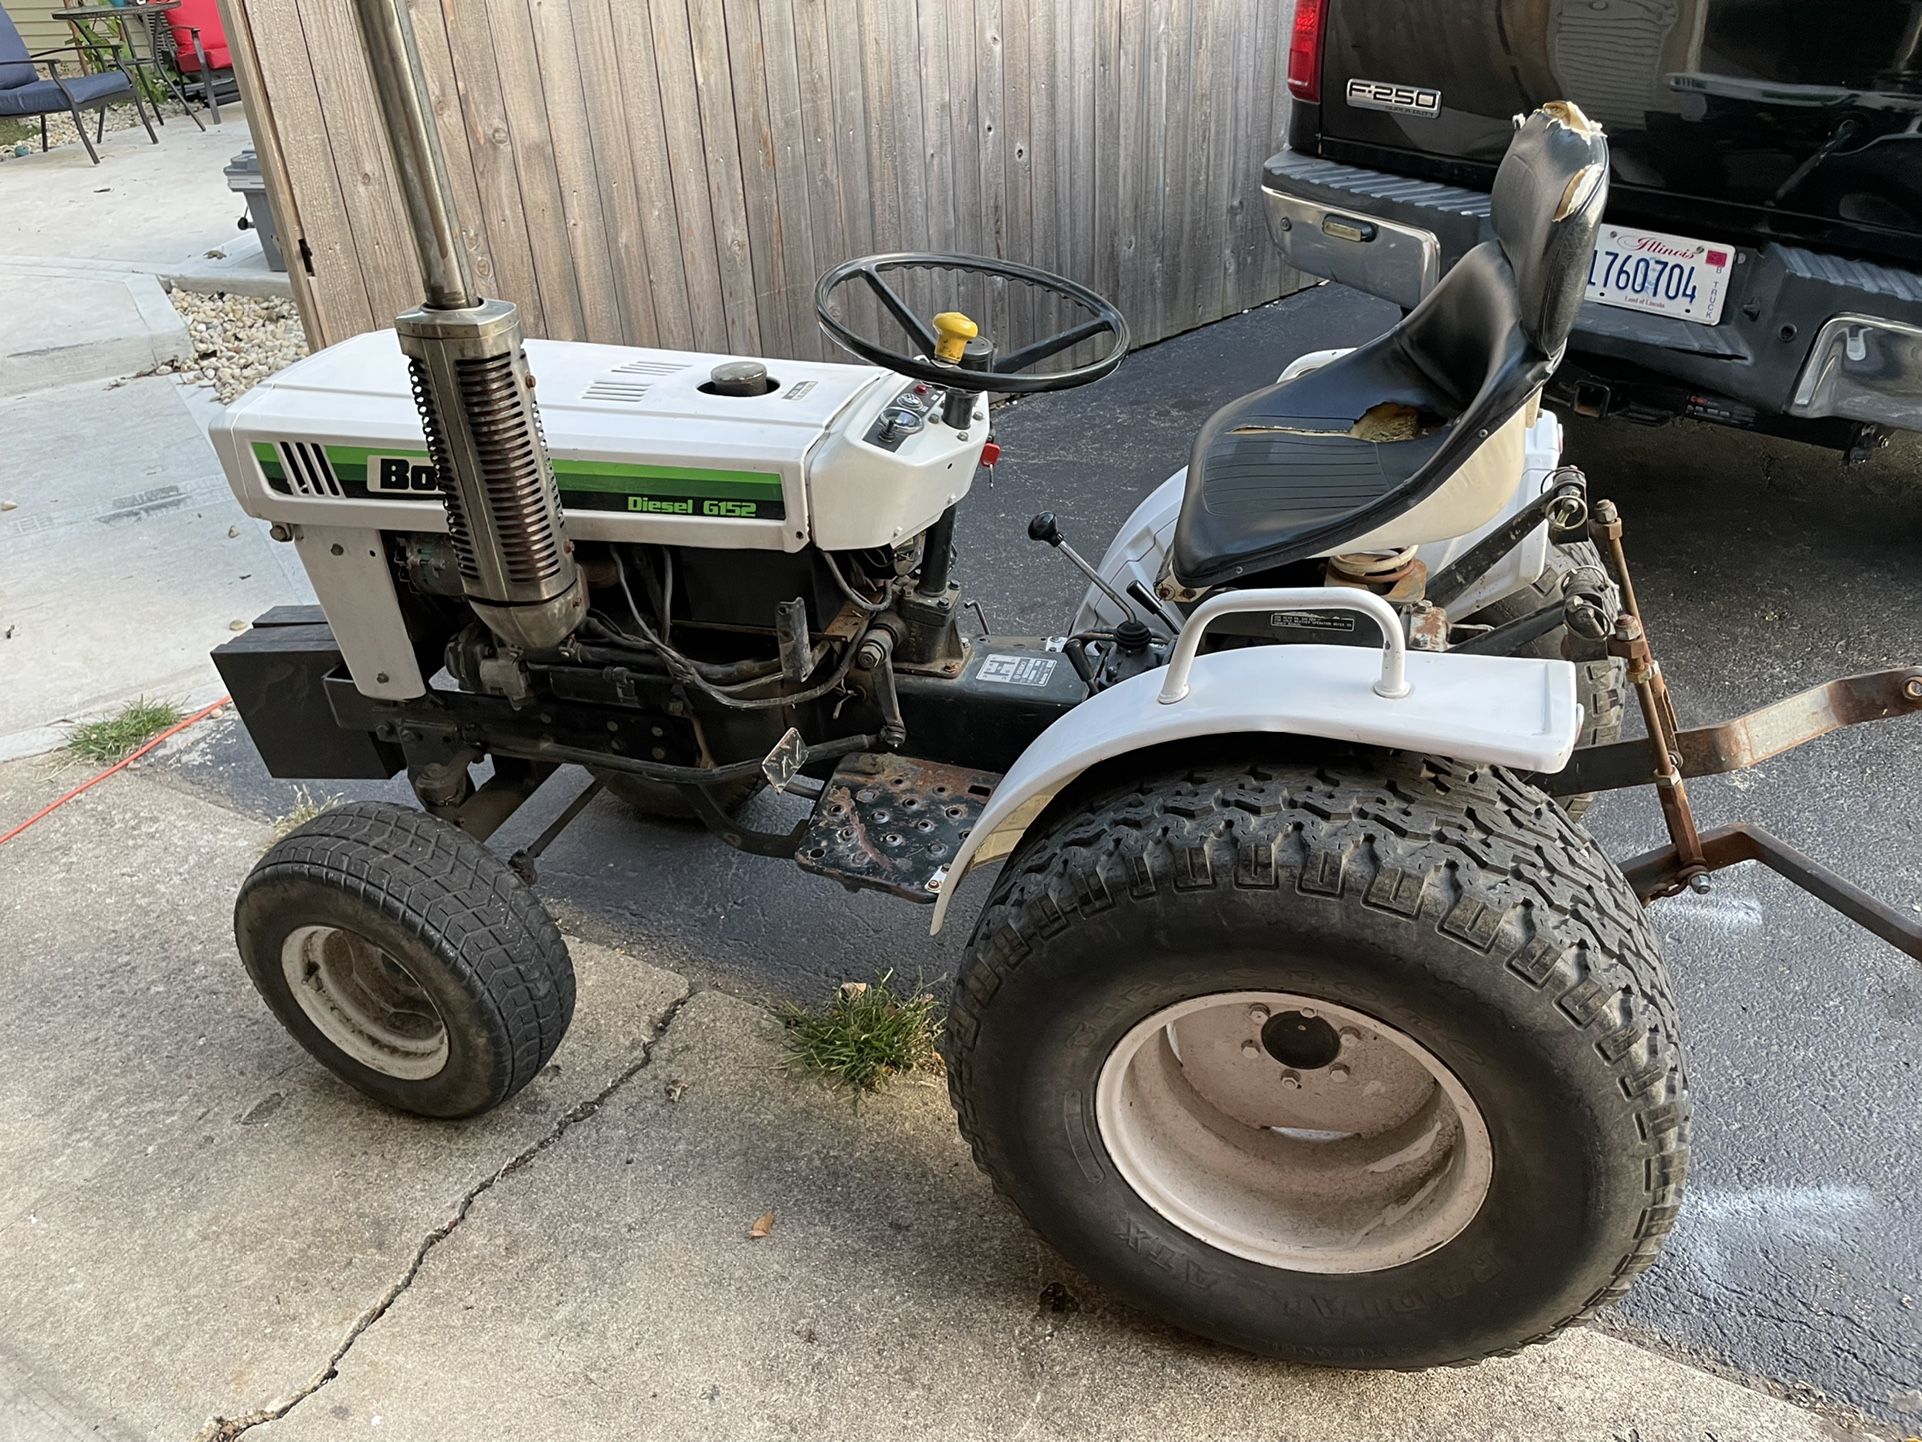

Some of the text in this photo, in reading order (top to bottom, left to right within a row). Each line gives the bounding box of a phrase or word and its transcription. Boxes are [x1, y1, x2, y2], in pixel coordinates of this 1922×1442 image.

[1622, 234, 1695, 259] Illinois
[1588, 249, 1697, 304] 1760704
[1624, 295, 1638, 304] Land
[1706, 282, 1720, 319] TRUCK
[380, 458, 438, 490] Bo
[628, 496, 693, 514] Diesel
